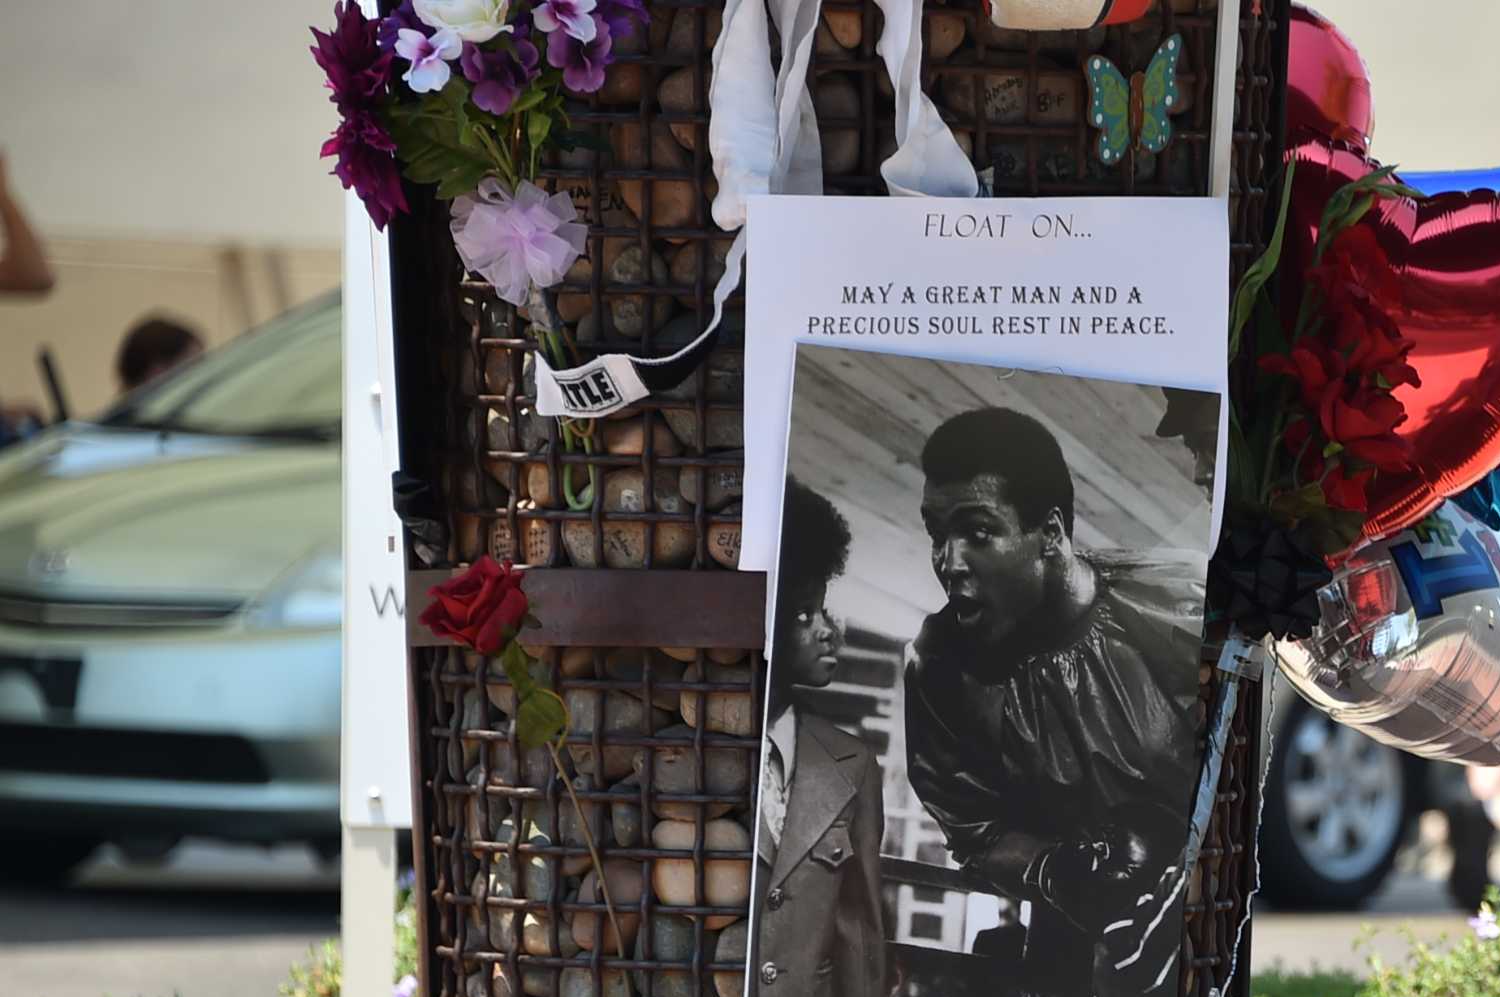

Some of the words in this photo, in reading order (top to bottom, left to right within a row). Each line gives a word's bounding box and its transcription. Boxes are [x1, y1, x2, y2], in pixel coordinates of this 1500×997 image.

[924, 213, 1013, 238] FLOAT
[1031, 213, 1092, 239] ON...
[841, 281, 895, 305] MAY
[900, 285, 918, 305] A
[925, 285, 1003, 305] GREAT
[1011, 285, 1062, 305] MAN
[1070, 285, 1118, 305] AND
[1127, 285, 1143, 305] A
[807, 316, 920, 336] PRECIOUS
[928, 316, 984, 335] SOUL
[991, 316, 1051, 336] REST
[1059, 316, 1081, 335] IN
[1090, 316, 1175, 335] PEACE.
[561, 370, 616, 409] ITLE
